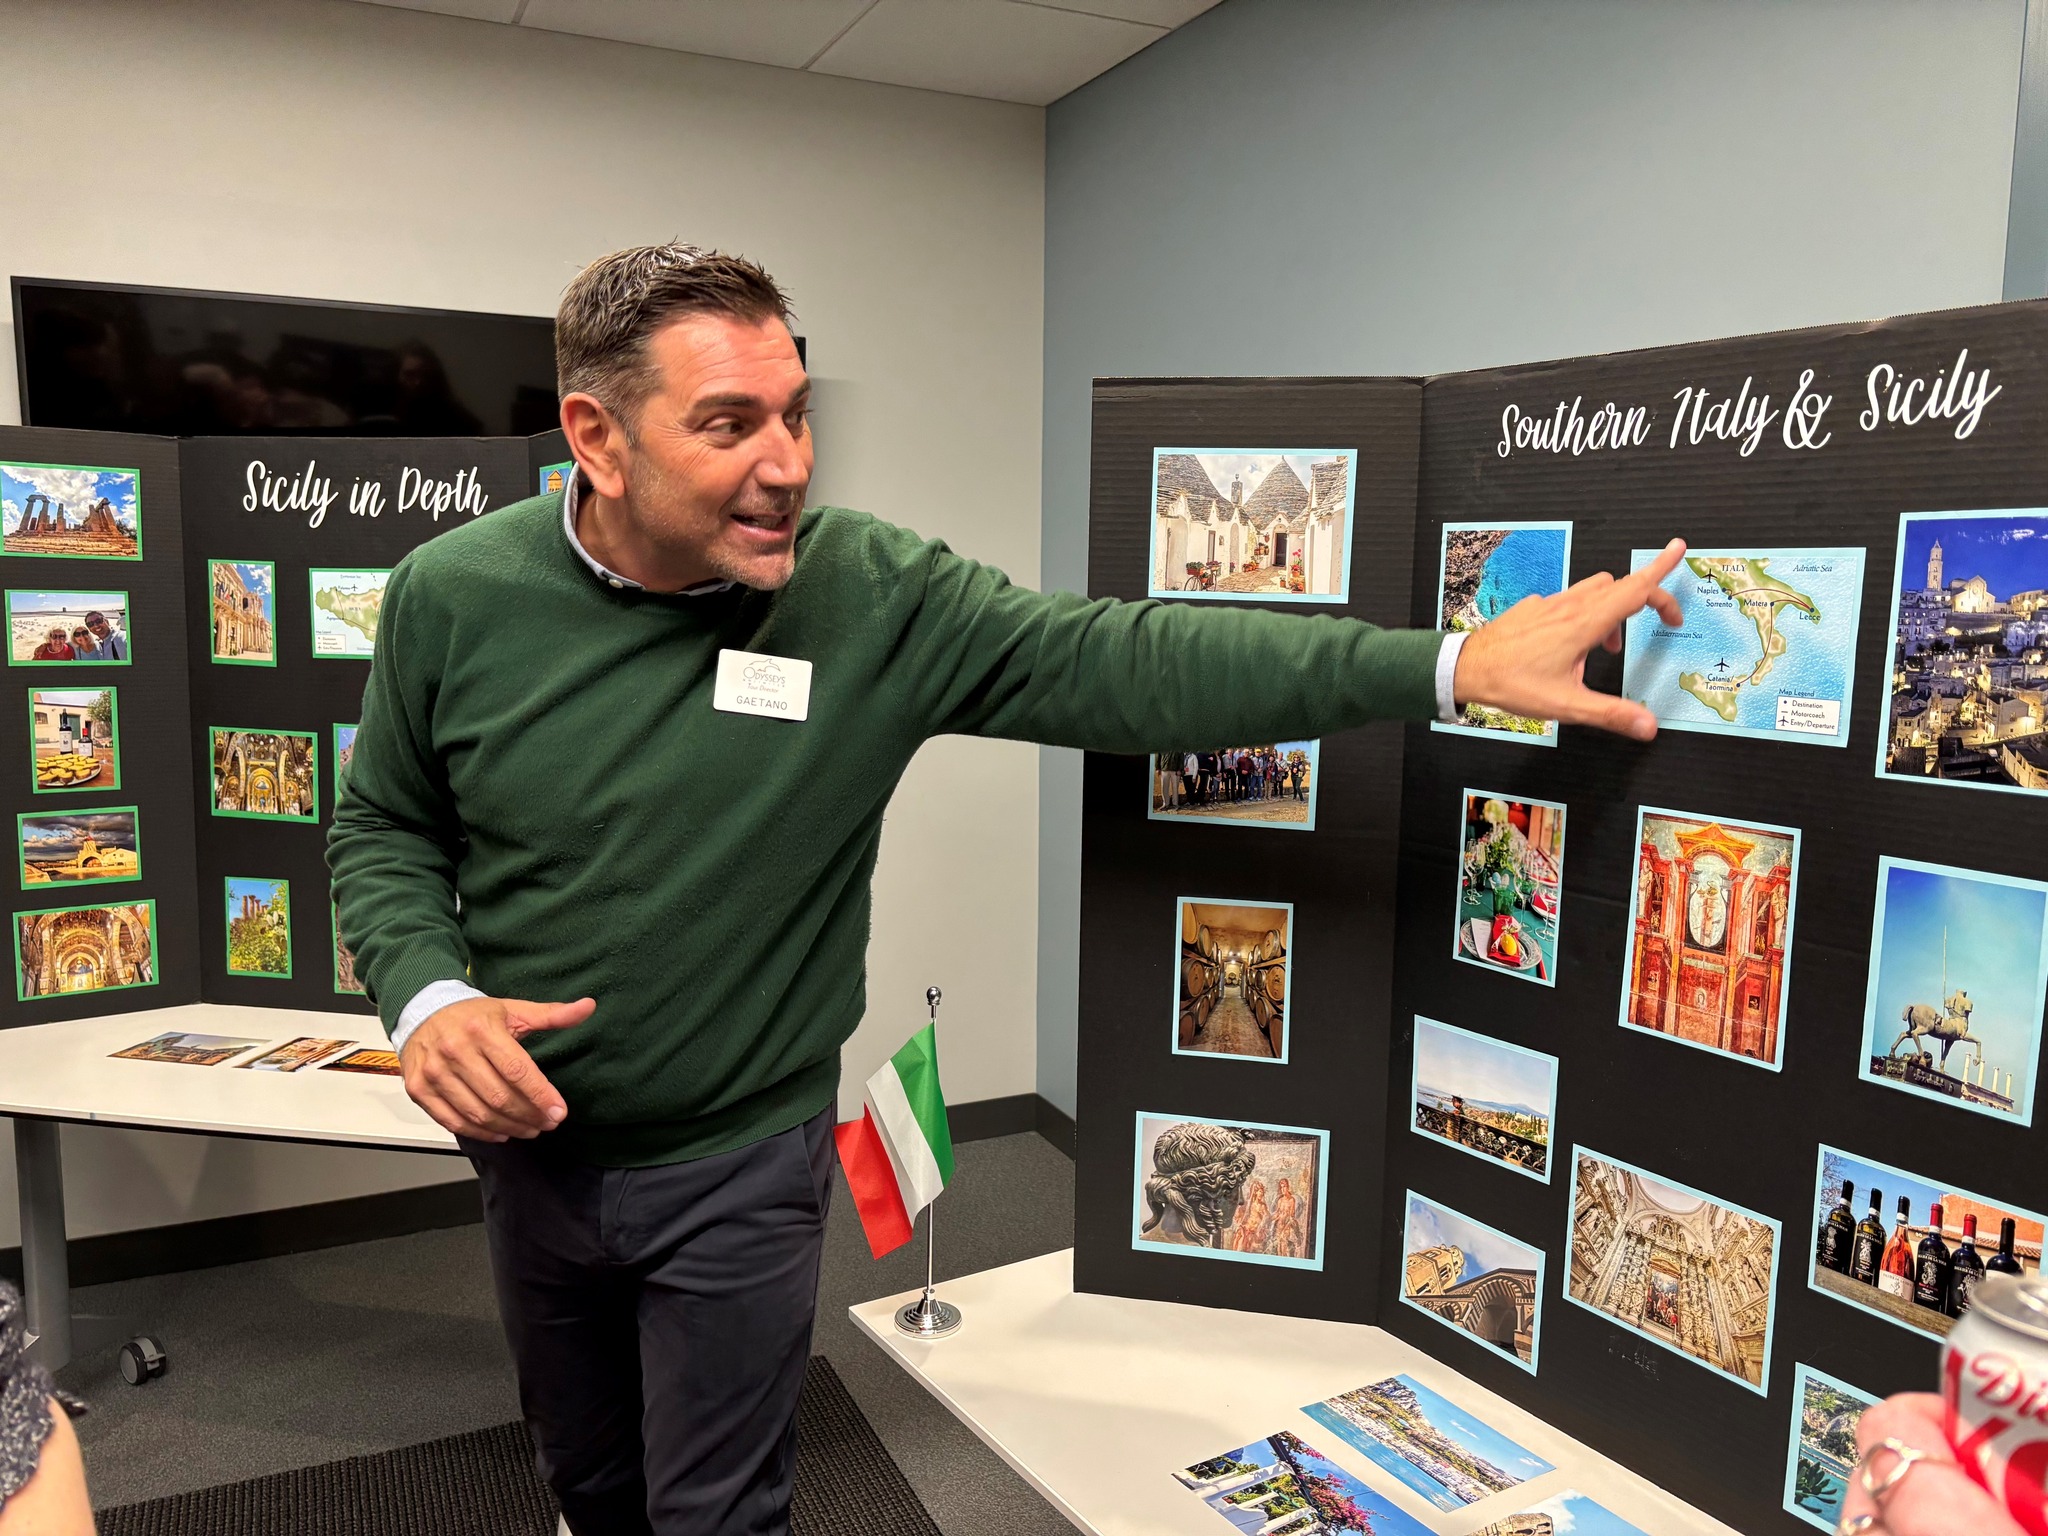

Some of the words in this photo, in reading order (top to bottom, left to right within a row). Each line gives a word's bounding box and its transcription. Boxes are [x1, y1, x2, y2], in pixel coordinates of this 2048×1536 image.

[1497, 395, 1652, 458] Southern
[1669, 376, 1779, 457] Italy
[1783, 368, 1833, 450] &
[1859, 347, 2003, 440] Sicily
[243, 459, 339, 529] Sicily
[349, 476, 386, 518] in
[398, 466, 489, 521] Depth
[1721, 564, 1747, 573] ITALY
[1792, 564, 1819, 573] Adriatic
[1818, 565, 1833, 573] Sea
[1696, 586, 1719, 595] Naples
[1705, 599, 1733, 608] Sorrento
[1743, 599, 1768, 608] Matera
[1799, 612, 1821, 621] Lecce
[743, 666, 786, 684] ODYSSEYS
[1707, 674, 1734, 683] Catania/
[1705, 682, 1734, 692] Taormina
[1778, 688, 1792, 698] Map
[1793, 689, 1815, 699] Legend
[736, 695, 788, 711] GAETANO
[1792, 700, 1823, 709] Destination
[1791, 710, 1825, 719] Motorcoach
[1790, 719, 1835, 731] Entry/Departure
